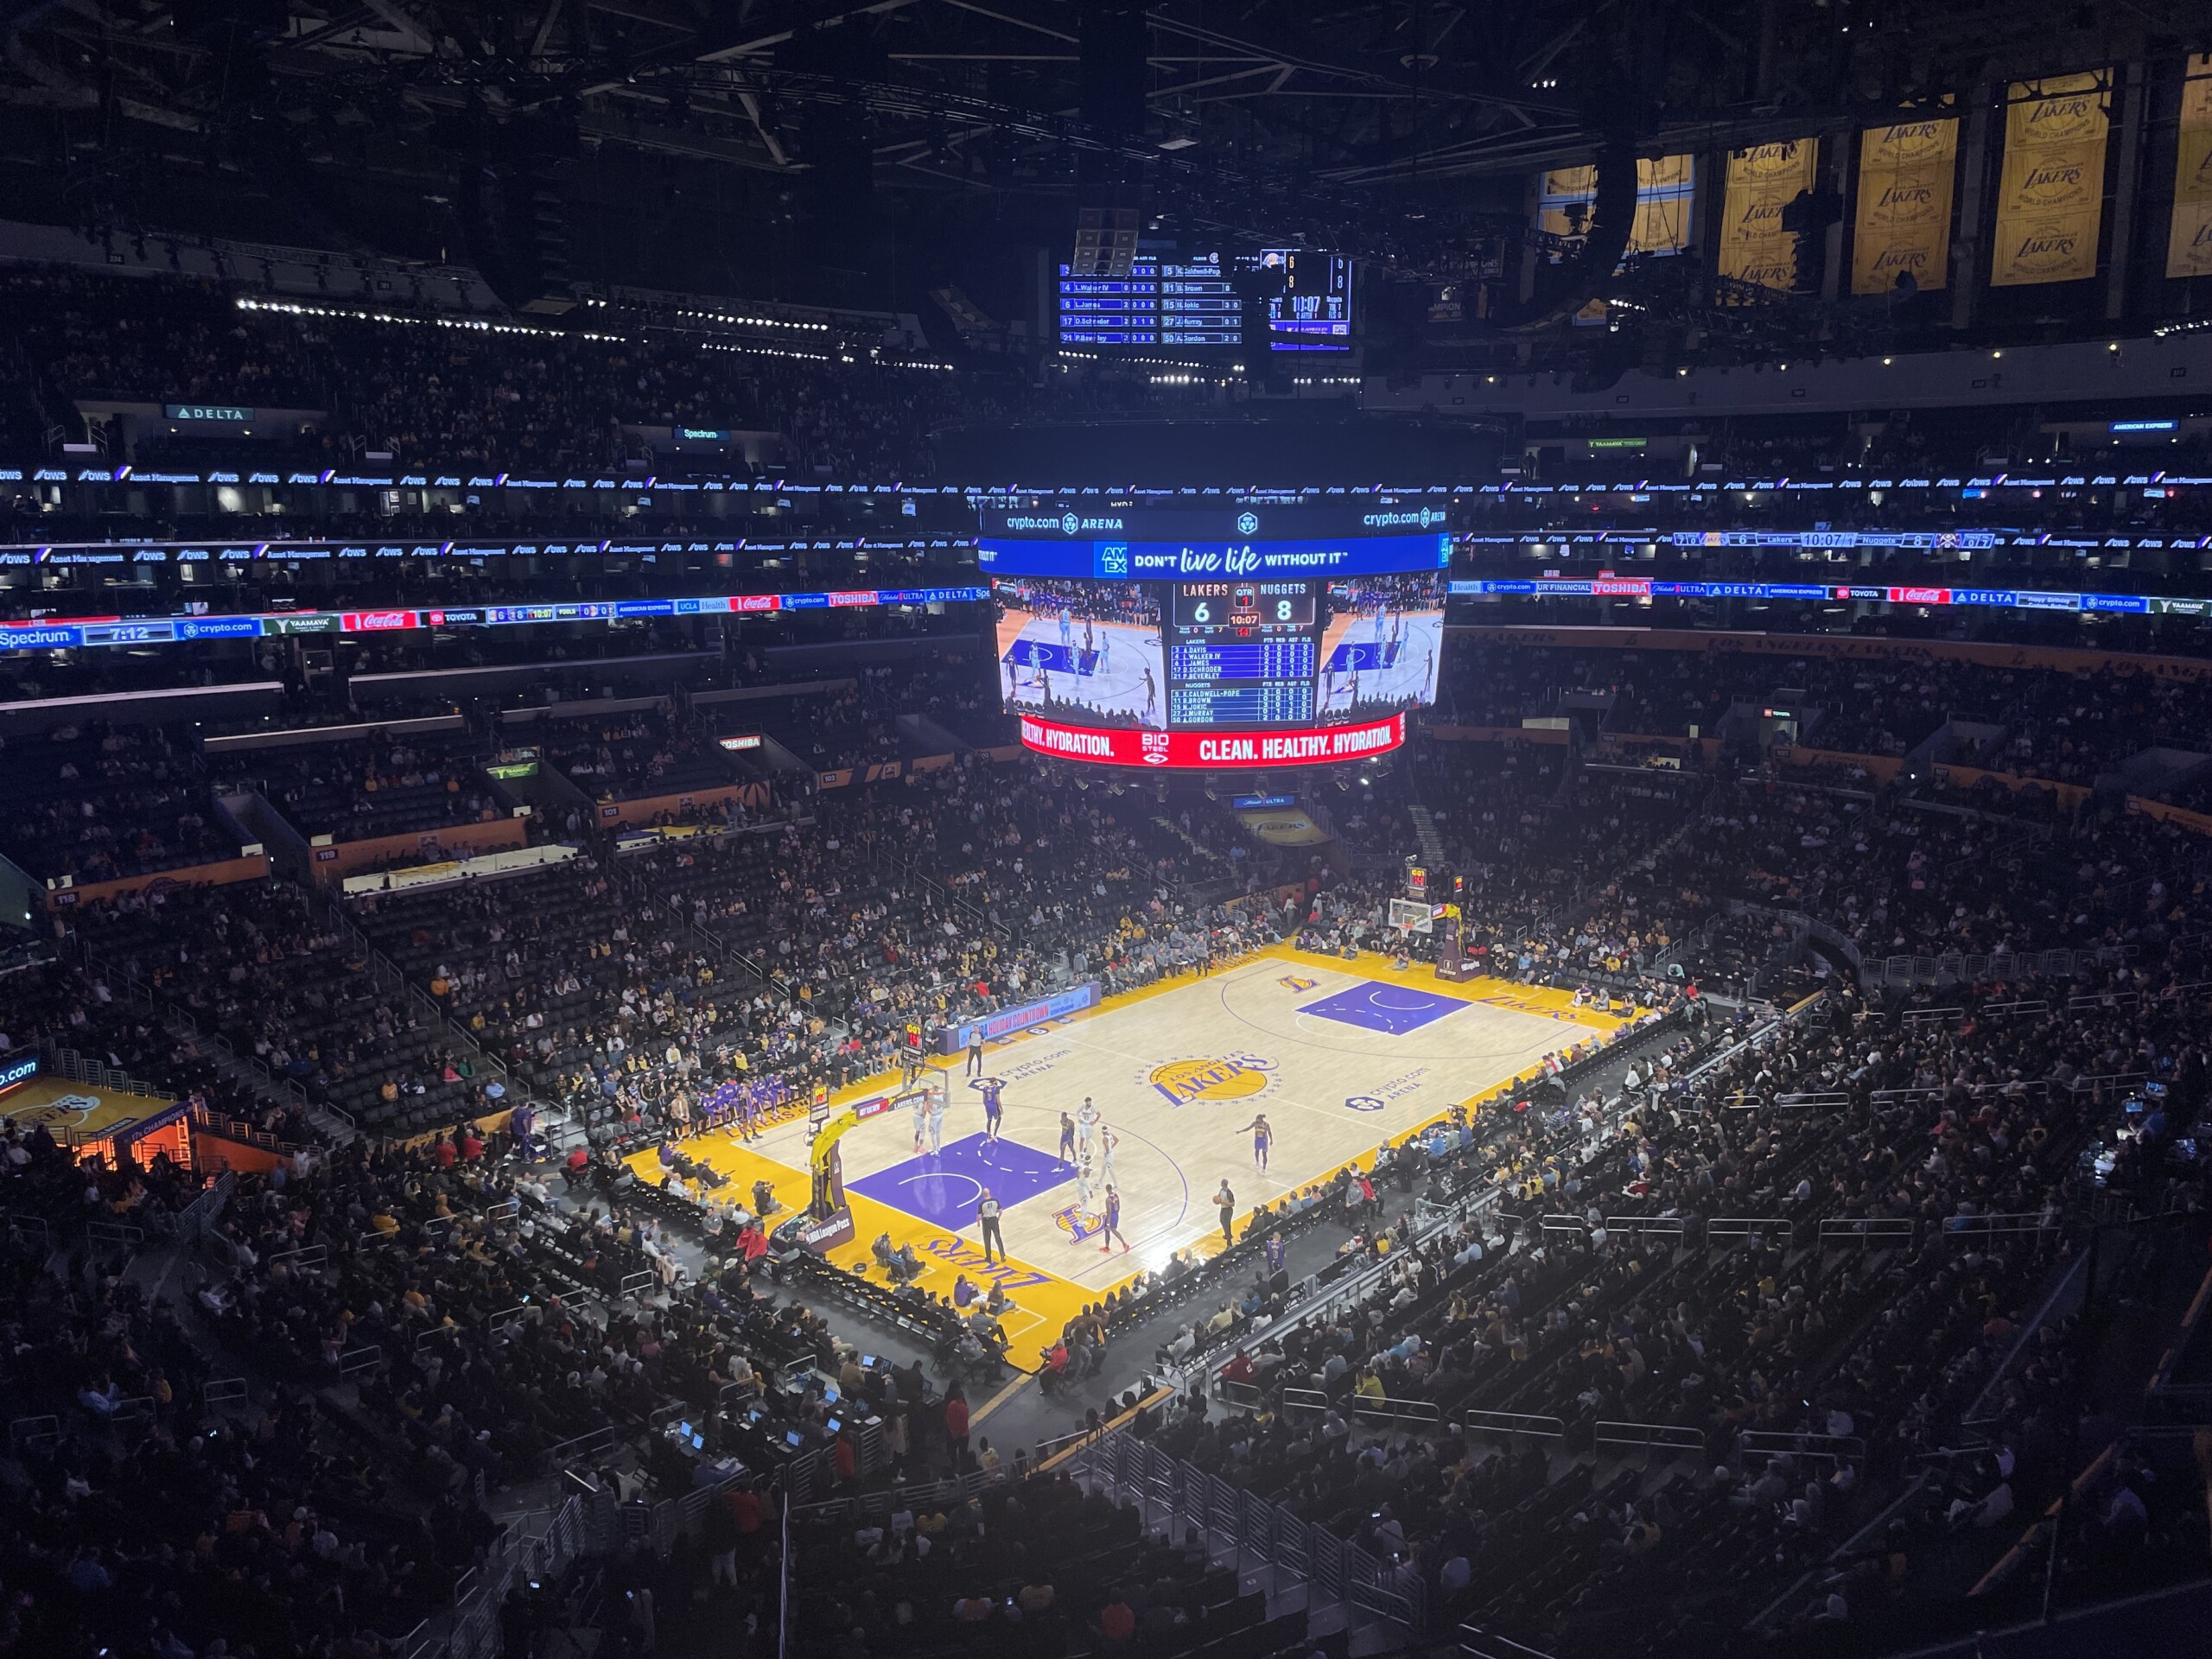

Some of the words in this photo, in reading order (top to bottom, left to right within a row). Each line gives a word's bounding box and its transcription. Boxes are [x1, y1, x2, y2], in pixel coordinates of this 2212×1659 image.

[2031, 99, 2089, 123] LAKERS
[1884, 123, 1939, 143] LAKERS
[2024, 168, 2082, 189] LAKERS
[1878, 188, 1933, 207] LAKERS
[2018, 238, 2075, 257] LAKERS
[194, 409, 244, 420] DELTA
[683, 429, 717, 439] Spectrum
[44, 471, 67, 480] DWS
[88, 472, 111, 480] DWS
[218, 473, 239, 482] DWS
[257, 474, 279, 483] DWS
[297, 475, 317, 484] DWS
[1007, 517, 1059, 530] crypto.com
[1081, 518, 1123, 529] ARENA
[1363, 512, 1419, 526] crypto.com
[1738, 534, 1747, 544] 6
[1804, 533, 1841, 546] 10:07
[1862, 537, 1896, 545] Nuggets
[1914, 535, 1923, 545] 8
[6, 555, 30, 564] DWS
[143, 552, 167, 561] DWS
[187, 551, 209, 560] DWS
[229, 550, 251, 559] DWS
[1135, 555, 1177, 568] DON'T
[1179, 548, 1223, 573] live
[1225, 545, 1261, 575] life
[1265, 552, 1326, 567] WITHOUT
[1183, 584, 1228, 597] LAKERS
[1261, 583, 1306, 594] NUGGETS
[1550, 582, 1591, 592] FINANCIAL
[1596, 583, 1647, 594] TOSHIBA
[1680, 585, 1705, 594] ULTRA
[1725, 586, 1763, 594] DELTA
[831, 593, 876, 605] TOSHIBA
[1970, 594, 2012, 603] DELTA
[2099, 600, 2140, 608] crypto.com
[702, 601, 726, 610] Health
[1277, 601, 1292, 620] 8
[445, 613, 477, 621] TOYOTA
[1194, 602, 1210, 622] 6
[1230, 615, 1258, 625] 10:07
[110, 626, 149, 641] 7:12
[200, 623, 252, 634] crypto.com
[0, 631, 69, 648] Spectrum
[1046, 731, 1115, 757] HYDRATION.
[1142, 734, 1168, 745] BIO
[1199, 739, 1258, 760] CLEAN.
[1262, 736, 1331, 760] HEALTHY.
[1333, 725, 1392, 754] HYDRATION.
[320, 850, 336, 860] 119
[58, 893, 76, 904] 118
[1051, 1003, 1074, 1015] coinbase
[988, 1014, 1012, 1033] HOLIDAY
[1014, 1004, 1049, 1027] COUNTDOWN
[1000, 1049, 1072, 1077] crypto.com
[1169, 1071, 1192, 1082] LOS
[1194, 1049, 1244, 1073] ANGELES
[1014, 1064, 1055, 1080] ARENA
[1147, 1054, 1280, 1109] LAKERS
[1370, 1066, 1431, 1096] crypto.com
[1387, 1082, 1423, 1100] ARENA
[893, 1095, 925, 1110] LAKERS.COM
[143, 1109, 185, 1135] CHAMPIONS
